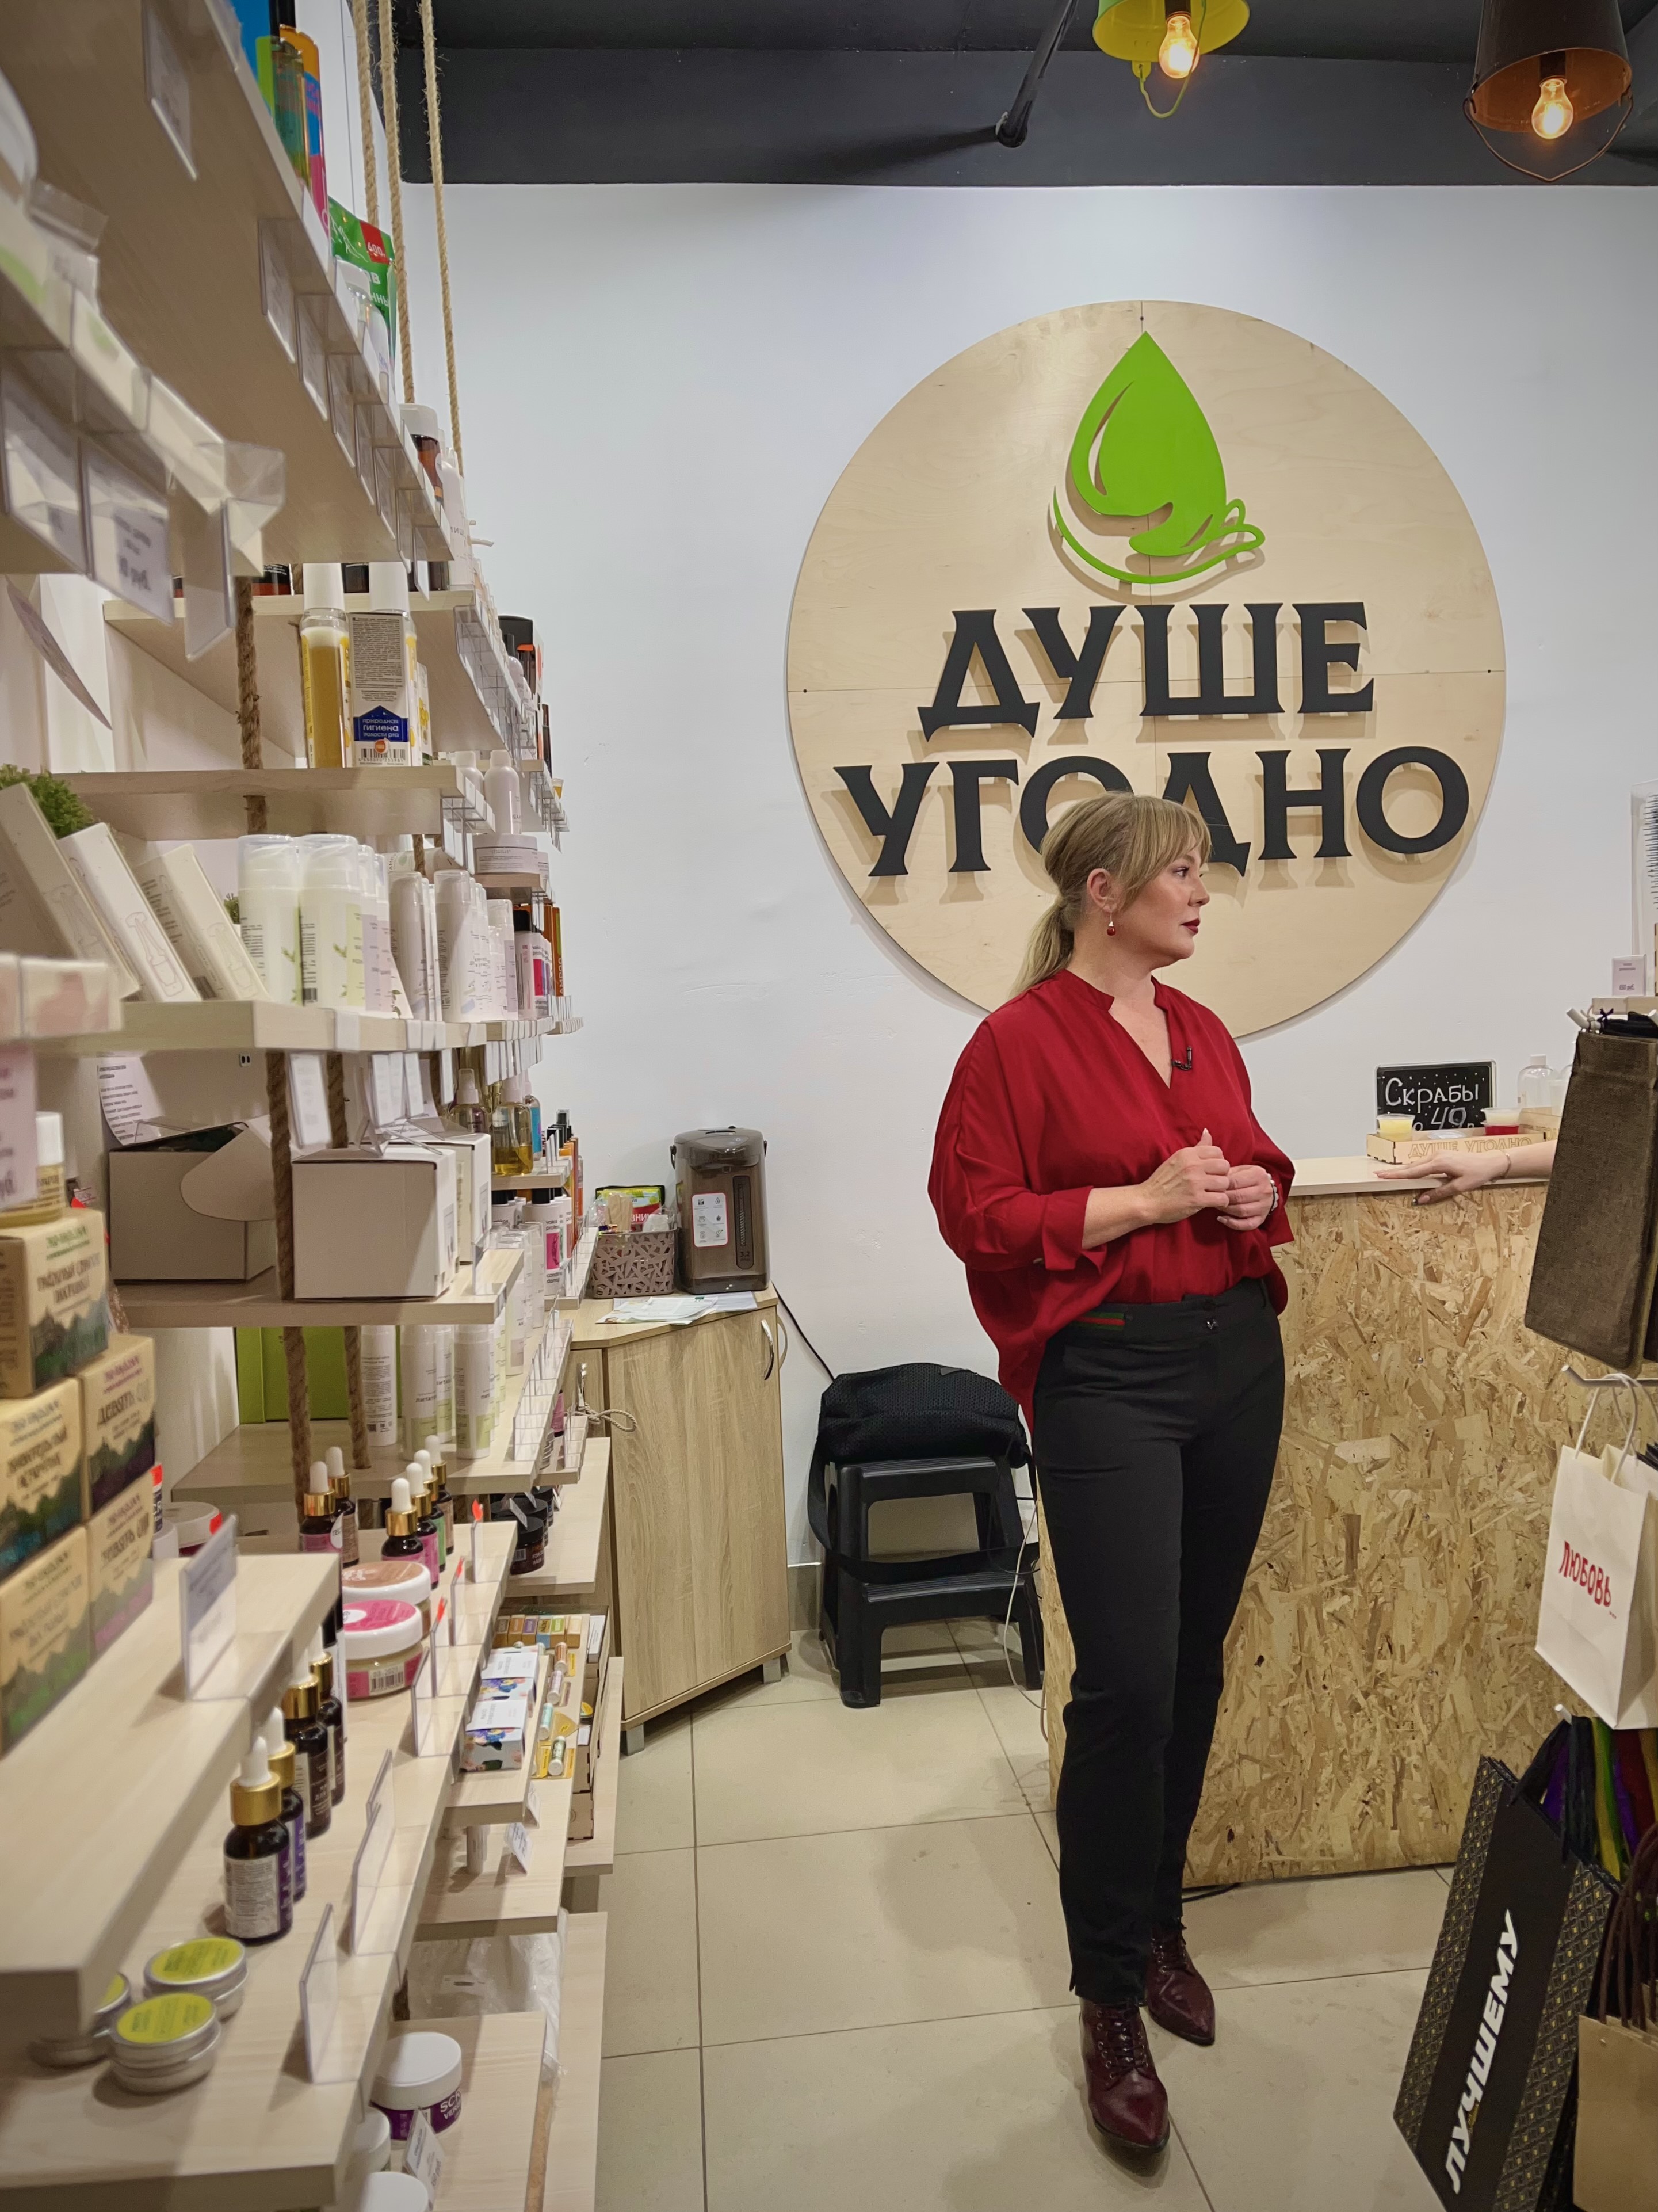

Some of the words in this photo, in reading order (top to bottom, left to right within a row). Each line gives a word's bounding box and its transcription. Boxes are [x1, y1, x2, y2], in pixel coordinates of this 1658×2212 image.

[917, 602, 1374, 742] ДУШЕ
[1431, 1107, 1466, 1130] 49
[1445, 1909, 1518, 2195] ЛУЧШЕМУ
